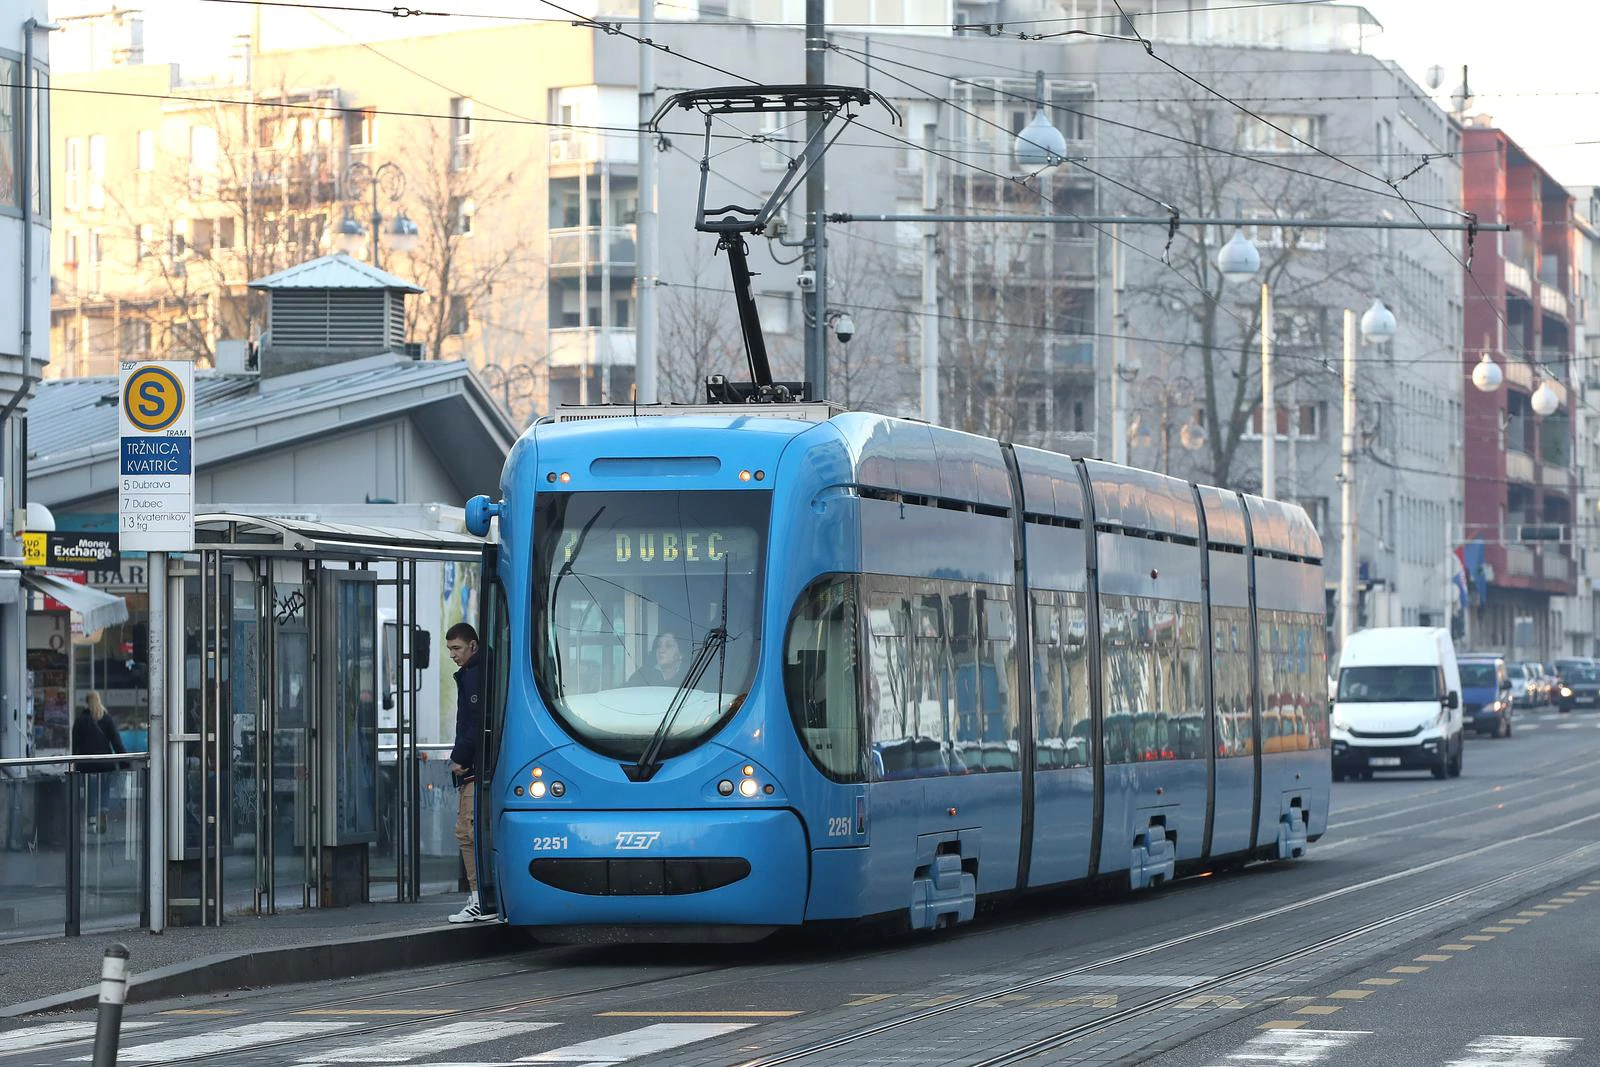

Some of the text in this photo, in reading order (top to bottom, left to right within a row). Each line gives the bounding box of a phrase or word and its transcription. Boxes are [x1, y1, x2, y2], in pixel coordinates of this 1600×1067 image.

[138, 381, 165, 416] S
[127, 440, 180, 455] TRŽNICA
[127, 457, 178, 472] KVATRIĆ
[123, 479, 171, 491] 5 Dubrava
[124, 498, 164, 510] 7 Dubec
[122, 513, 187, 528] 13 Kvaternikov
[136, 522, 148, 532] trg
[79, 539, 110, 550] Money
[615, 532, 724, 562] DUBEC
[94, 566, 144, 585] BAR
[828, 816, 852, 837] 2251
[533, 831, 661, 851] 2251 ZET
